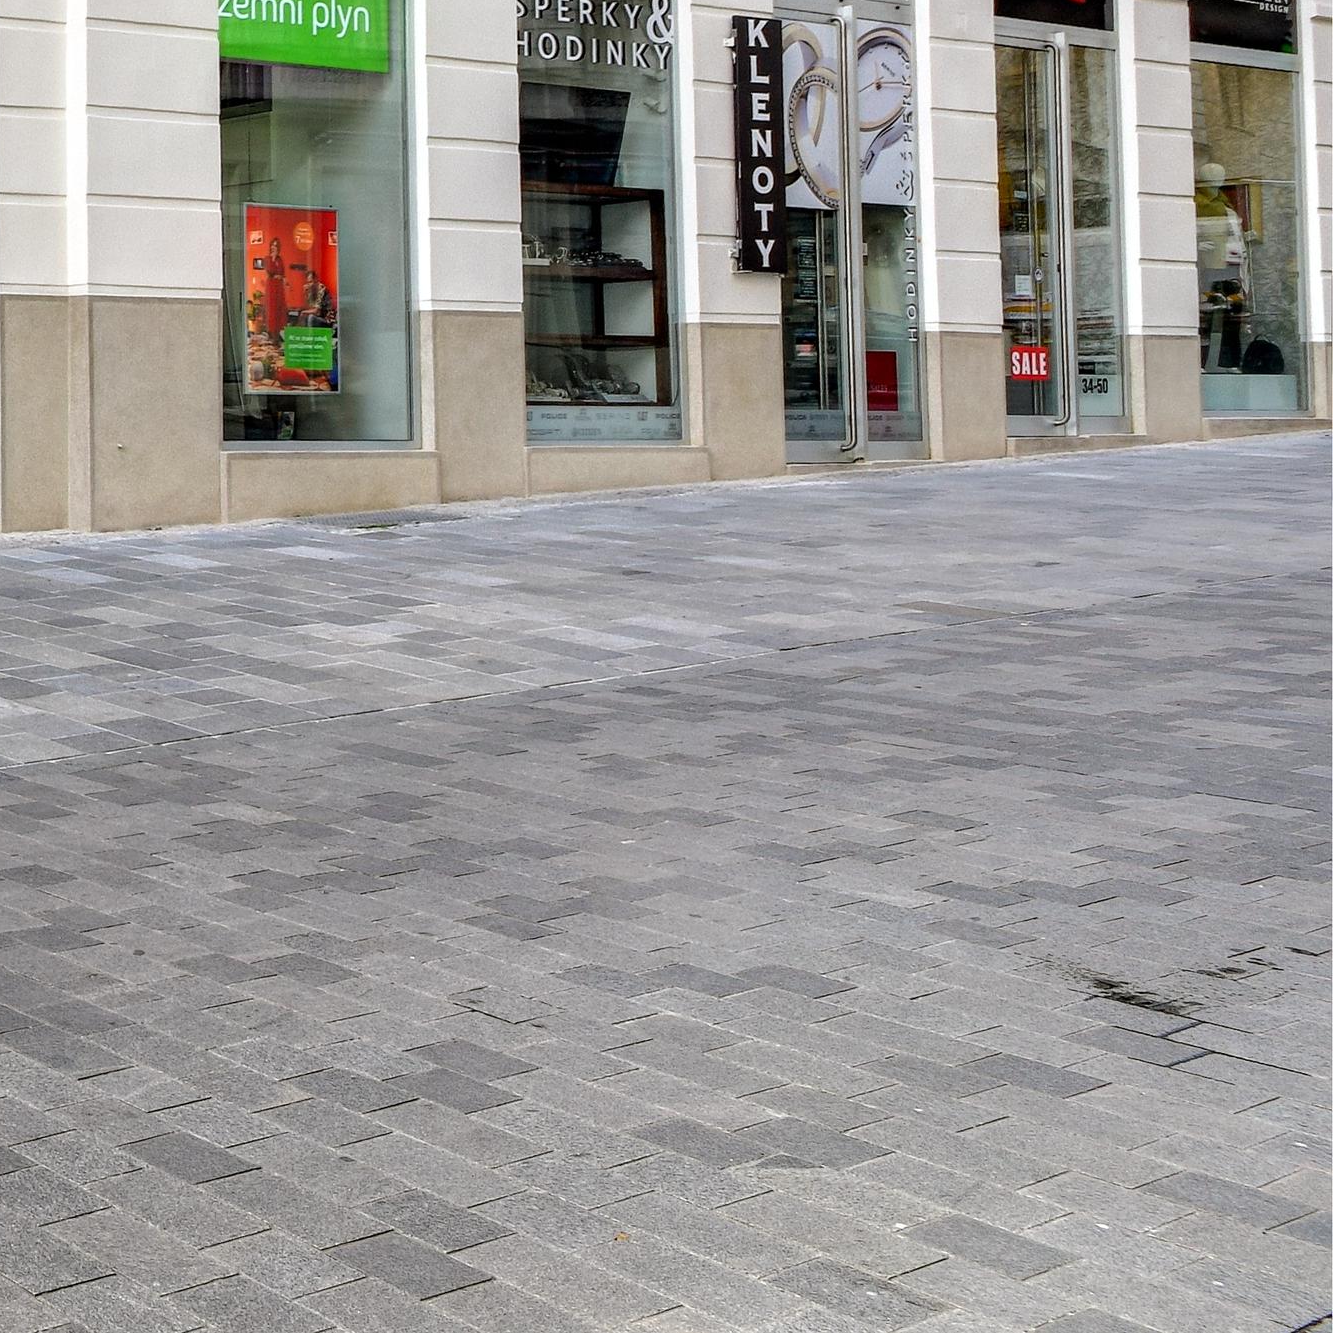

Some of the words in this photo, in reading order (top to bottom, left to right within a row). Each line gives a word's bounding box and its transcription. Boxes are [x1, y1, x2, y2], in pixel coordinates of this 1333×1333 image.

[1259, 3, 1288, 13] DESIGN
[746, 18, 776, 268] KLENOTY
[903, 209, 918, 341] HODINKY
[1011, 351, 1048, 376] SALE
[1081, 377, 1109, 394] 34-50
